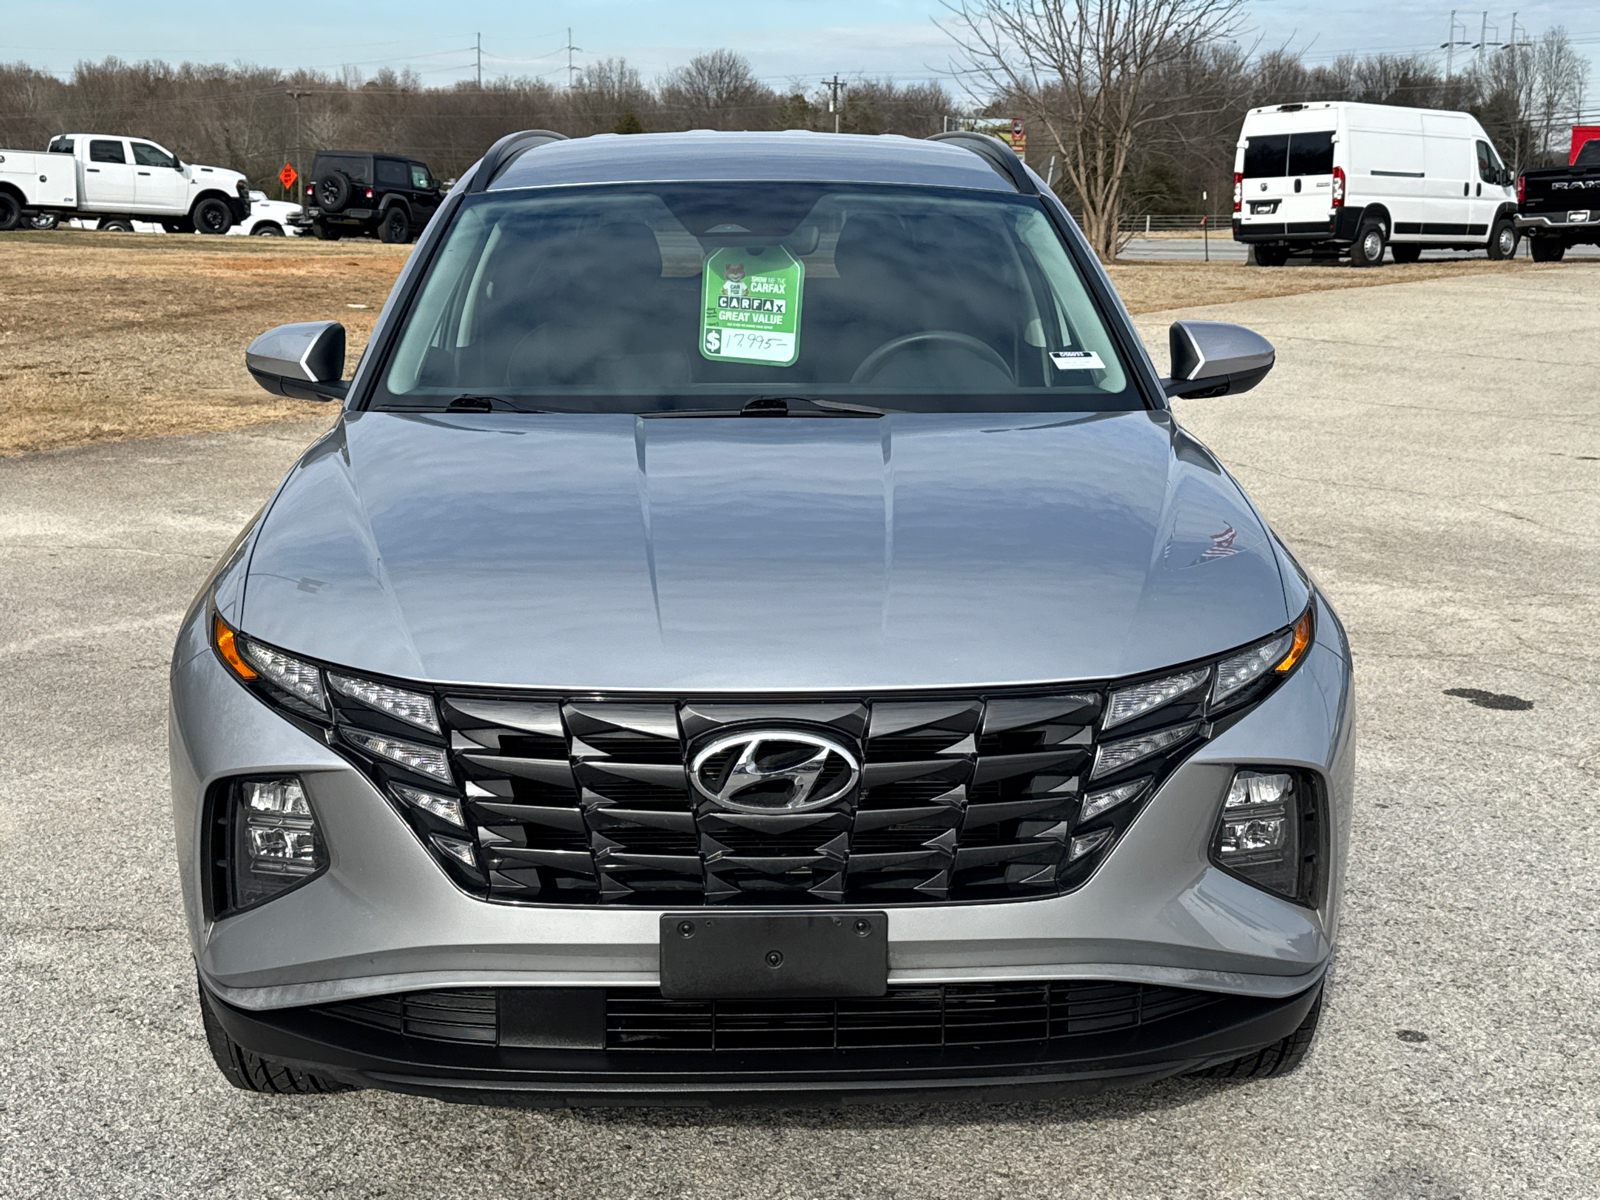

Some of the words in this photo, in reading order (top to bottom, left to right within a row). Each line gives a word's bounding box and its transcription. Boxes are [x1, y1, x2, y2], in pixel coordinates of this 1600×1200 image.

[1551, 181, 1600, 190] RAM
[750, 282, 786, 294] CARFAX
[719, 297, 784, 313] CARFAX
[718, 311, 750, 322] GREAT
[752, 313, 783, 325] VALUE
